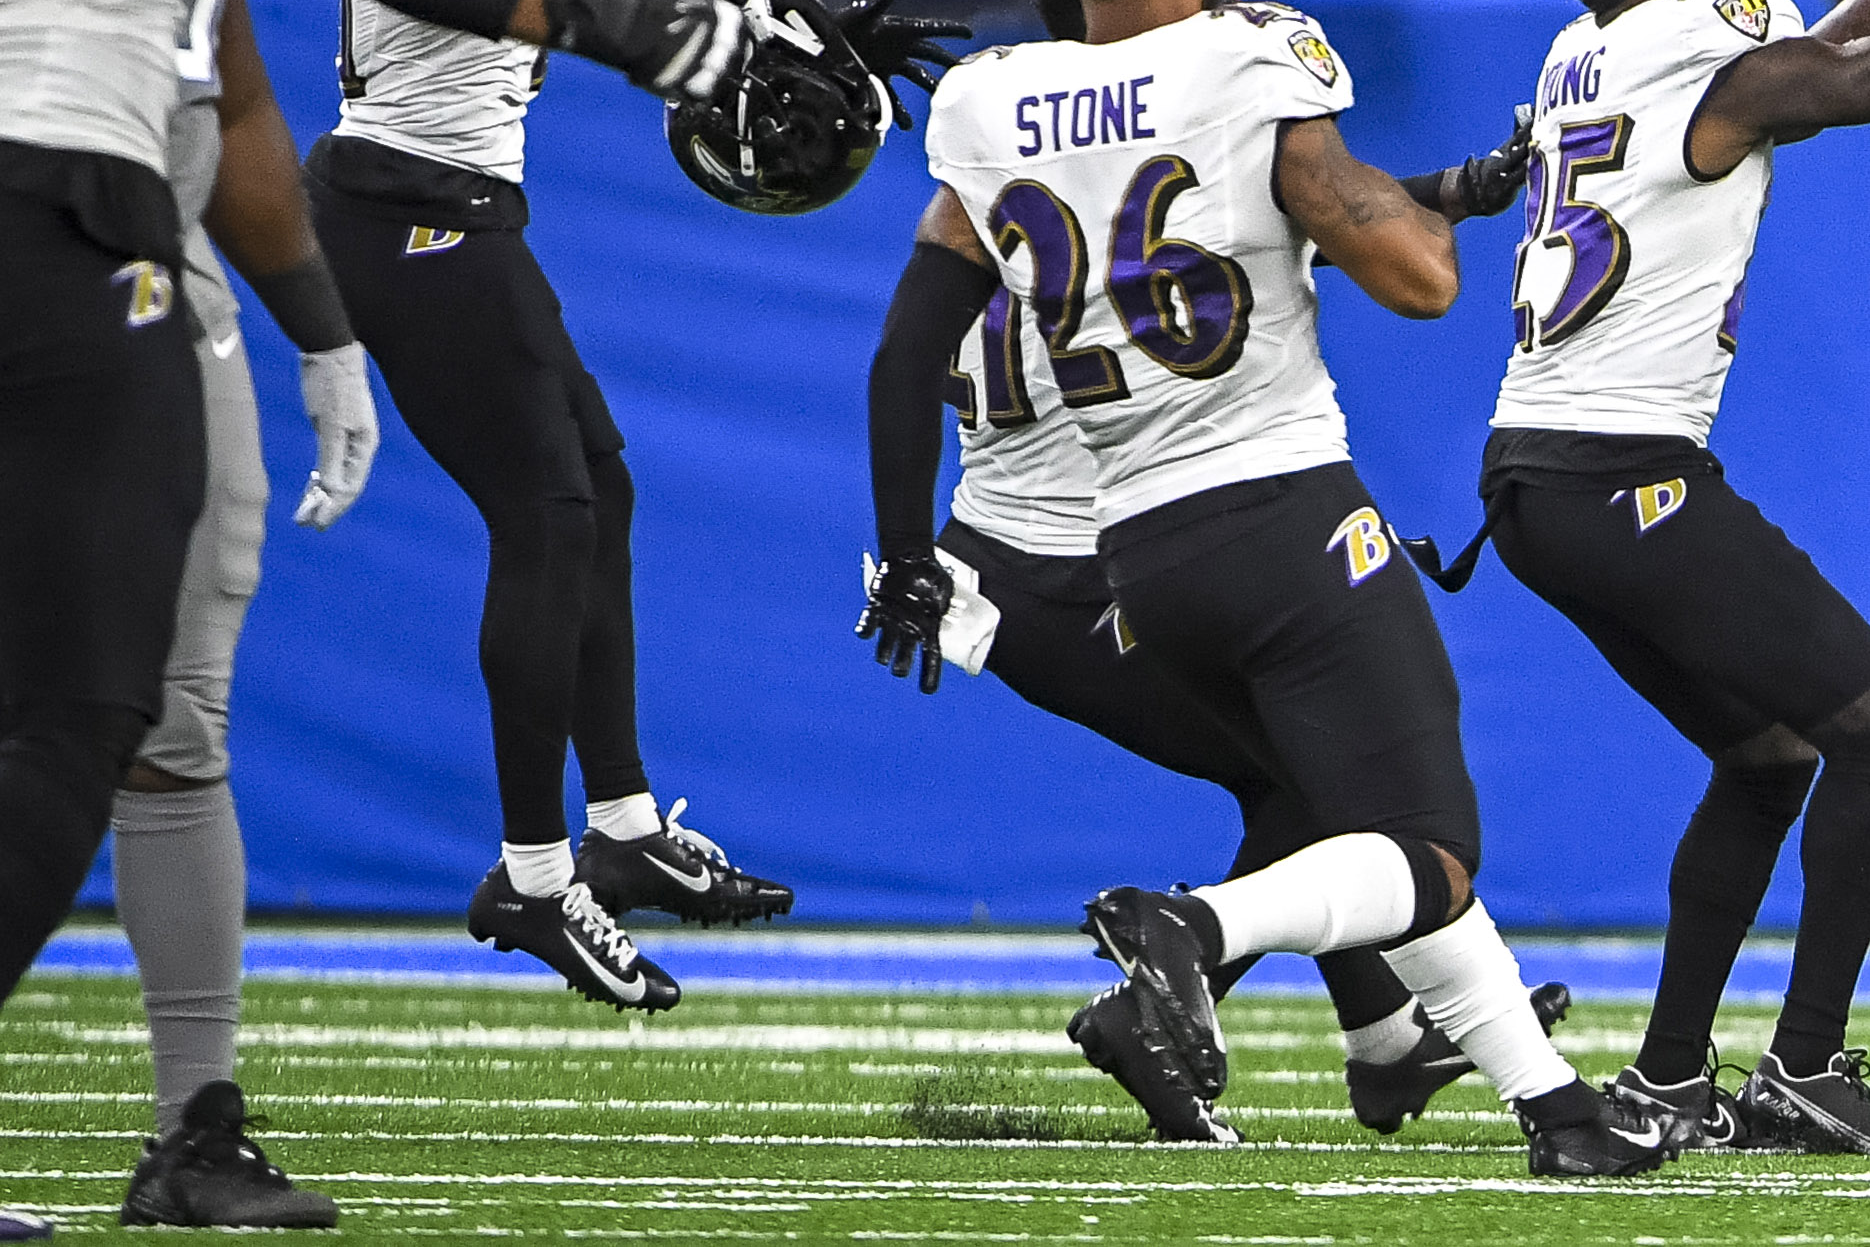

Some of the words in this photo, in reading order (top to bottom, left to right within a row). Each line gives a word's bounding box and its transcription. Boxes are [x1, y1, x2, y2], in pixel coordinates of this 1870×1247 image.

[1016, 75, 1156, 158] STONE
[986, 154, 1255, 409] 26
[1326, 506, 1392, 587] B
